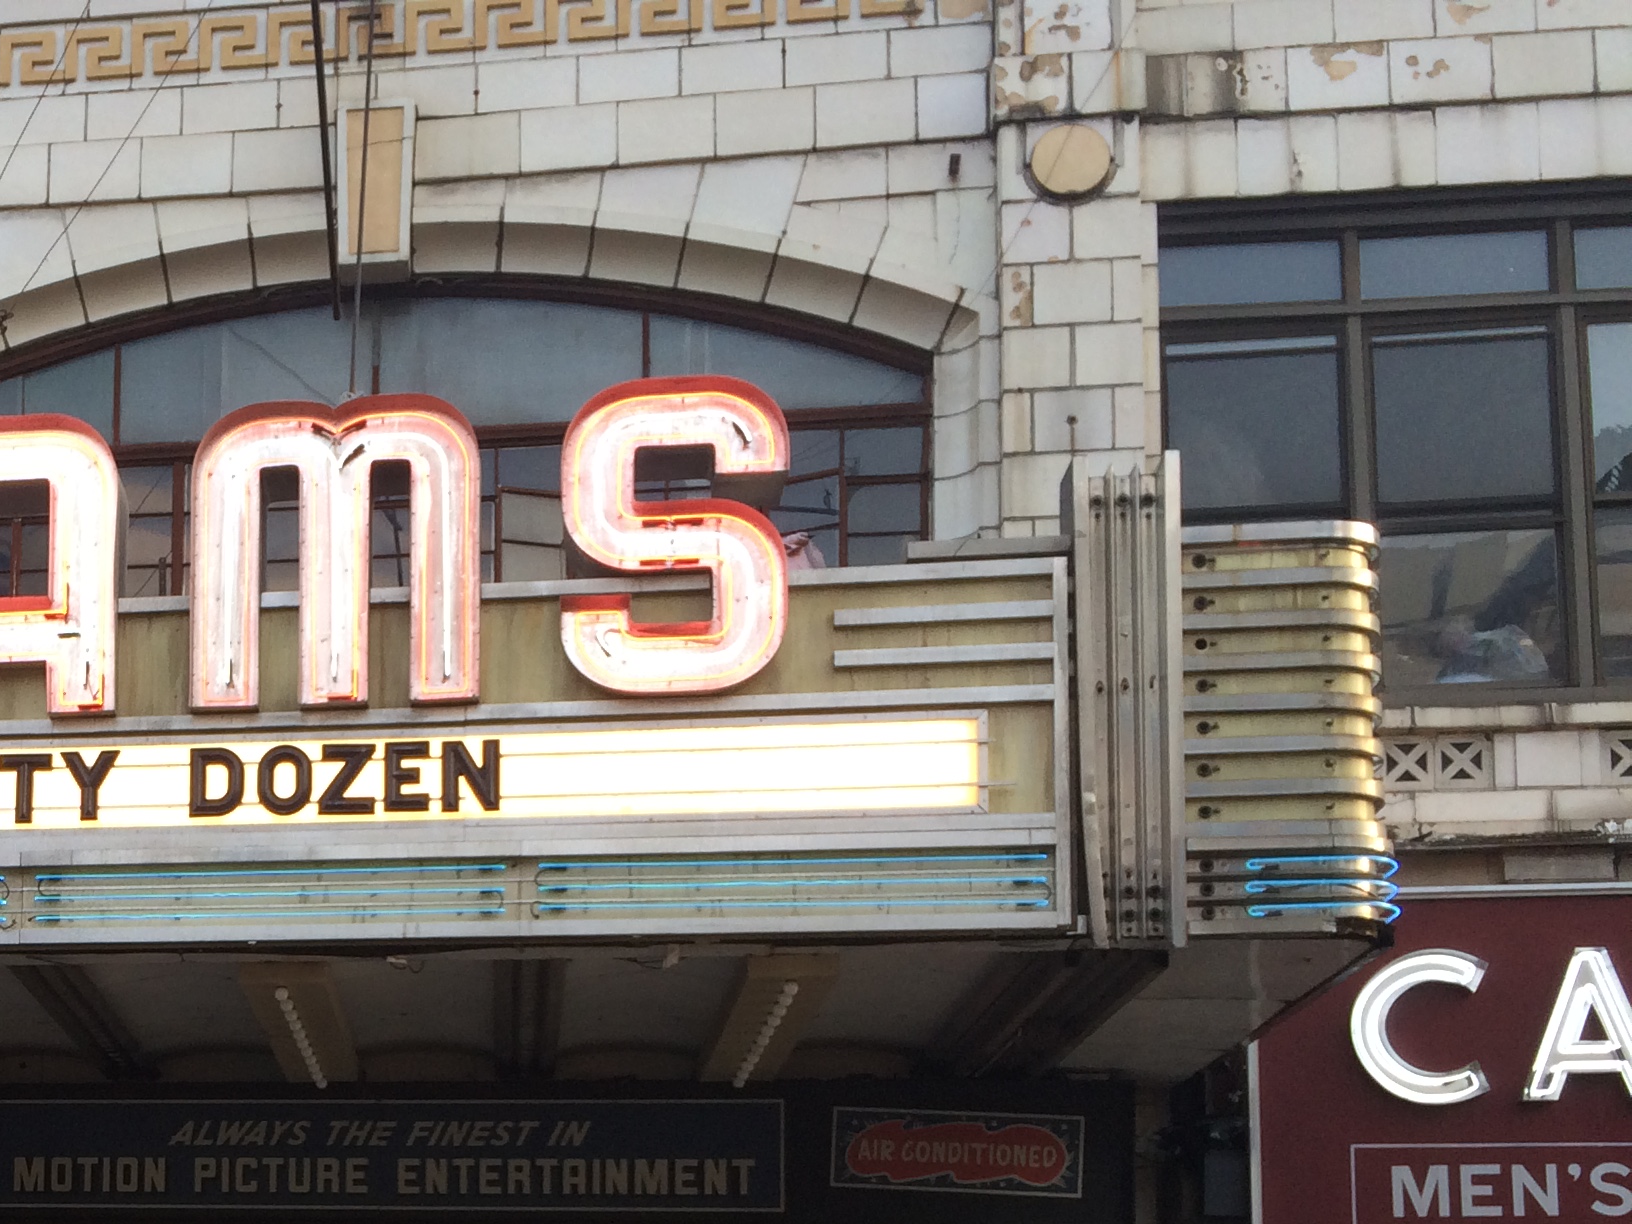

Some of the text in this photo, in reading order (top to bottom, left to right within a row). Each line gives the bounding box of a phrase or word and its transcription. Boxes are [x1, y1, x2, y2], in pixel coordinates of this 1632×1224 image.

[189, 740, 501, 817] DOZEN
[170, 1119, 592, 1147] ALWAYS THE FINEST IN
[857, 1138, 1059, 1169] AIR CONDITIONED
[12, 1156, 756, 1197] MOTION PICTURE ENTERTAINMENT
[1390, 1162, 1632, 1218] MEN'S
